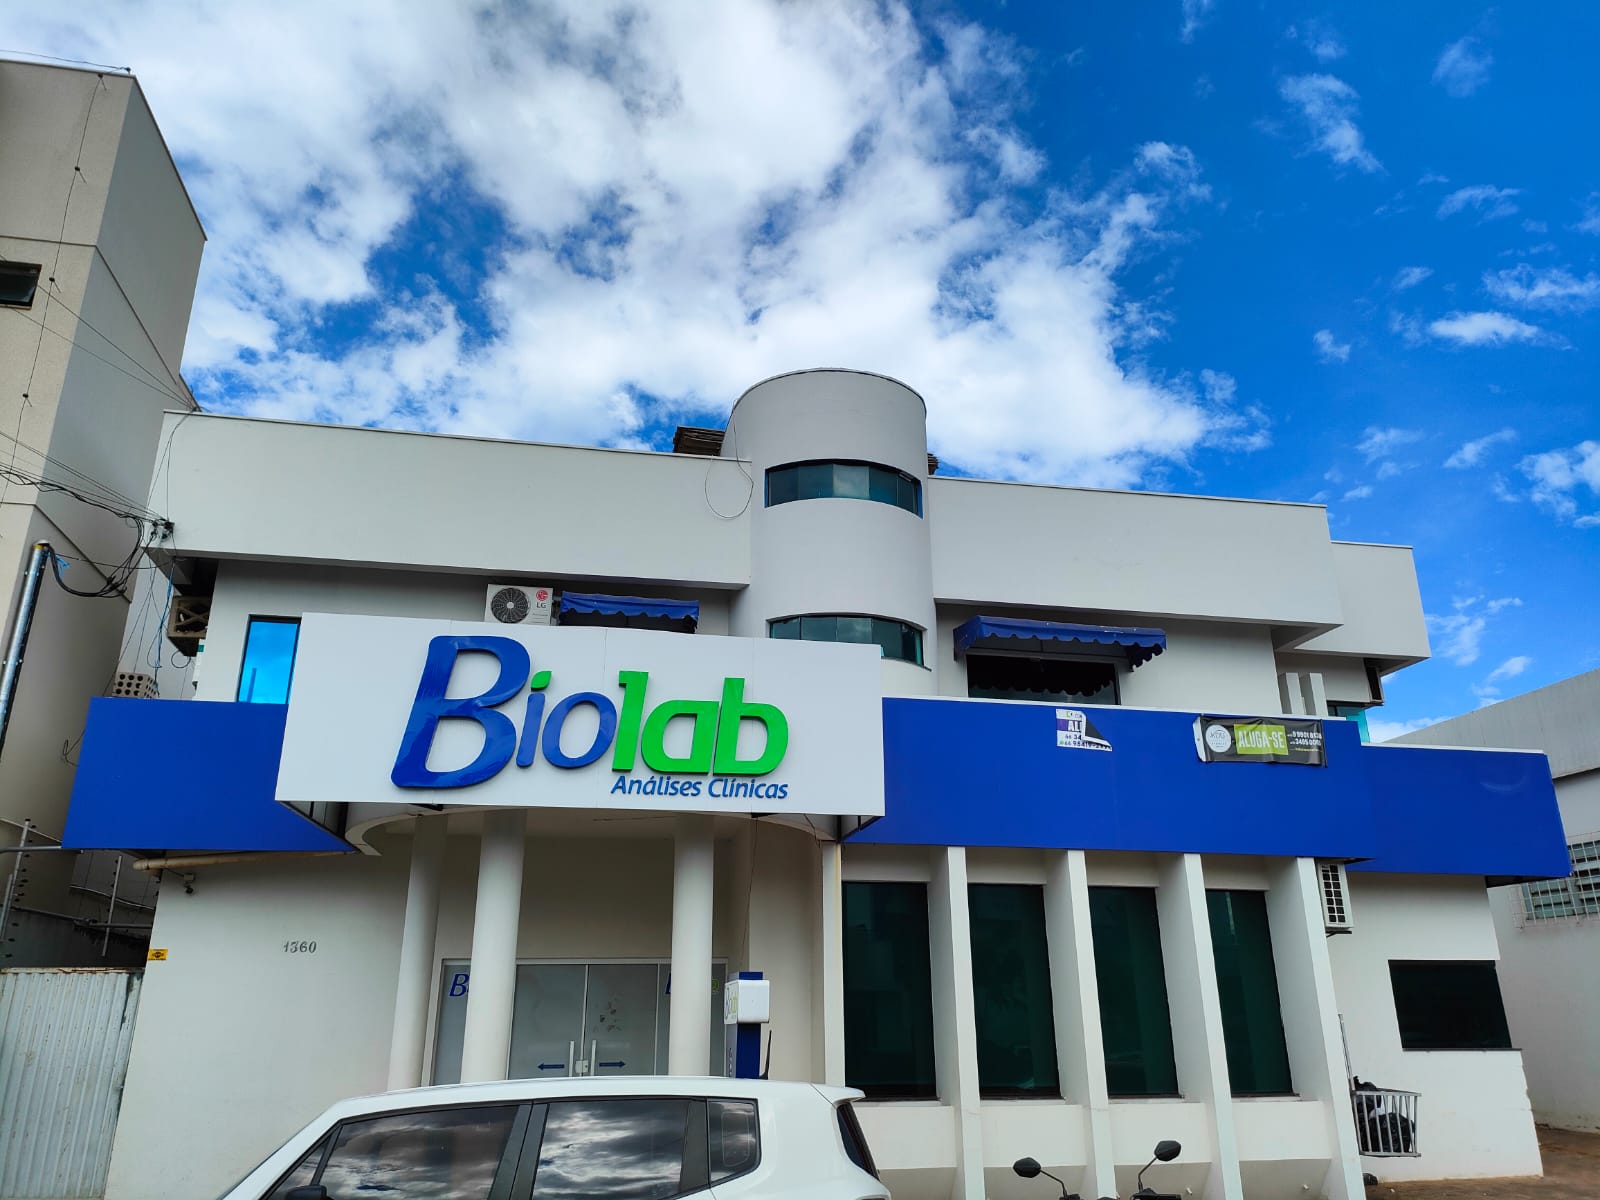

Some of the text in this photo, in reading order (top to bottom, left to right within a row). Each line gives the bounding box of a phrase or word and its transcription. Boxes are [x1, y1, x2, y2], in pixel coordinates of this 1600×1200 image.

[390, 634, 789, 789] Biolab
[1238, 730, 1285, 749] ALUGA-SE
[610, 775, 789, 800] Análises Clínicas
[283, 940, 317, 954] 1360
